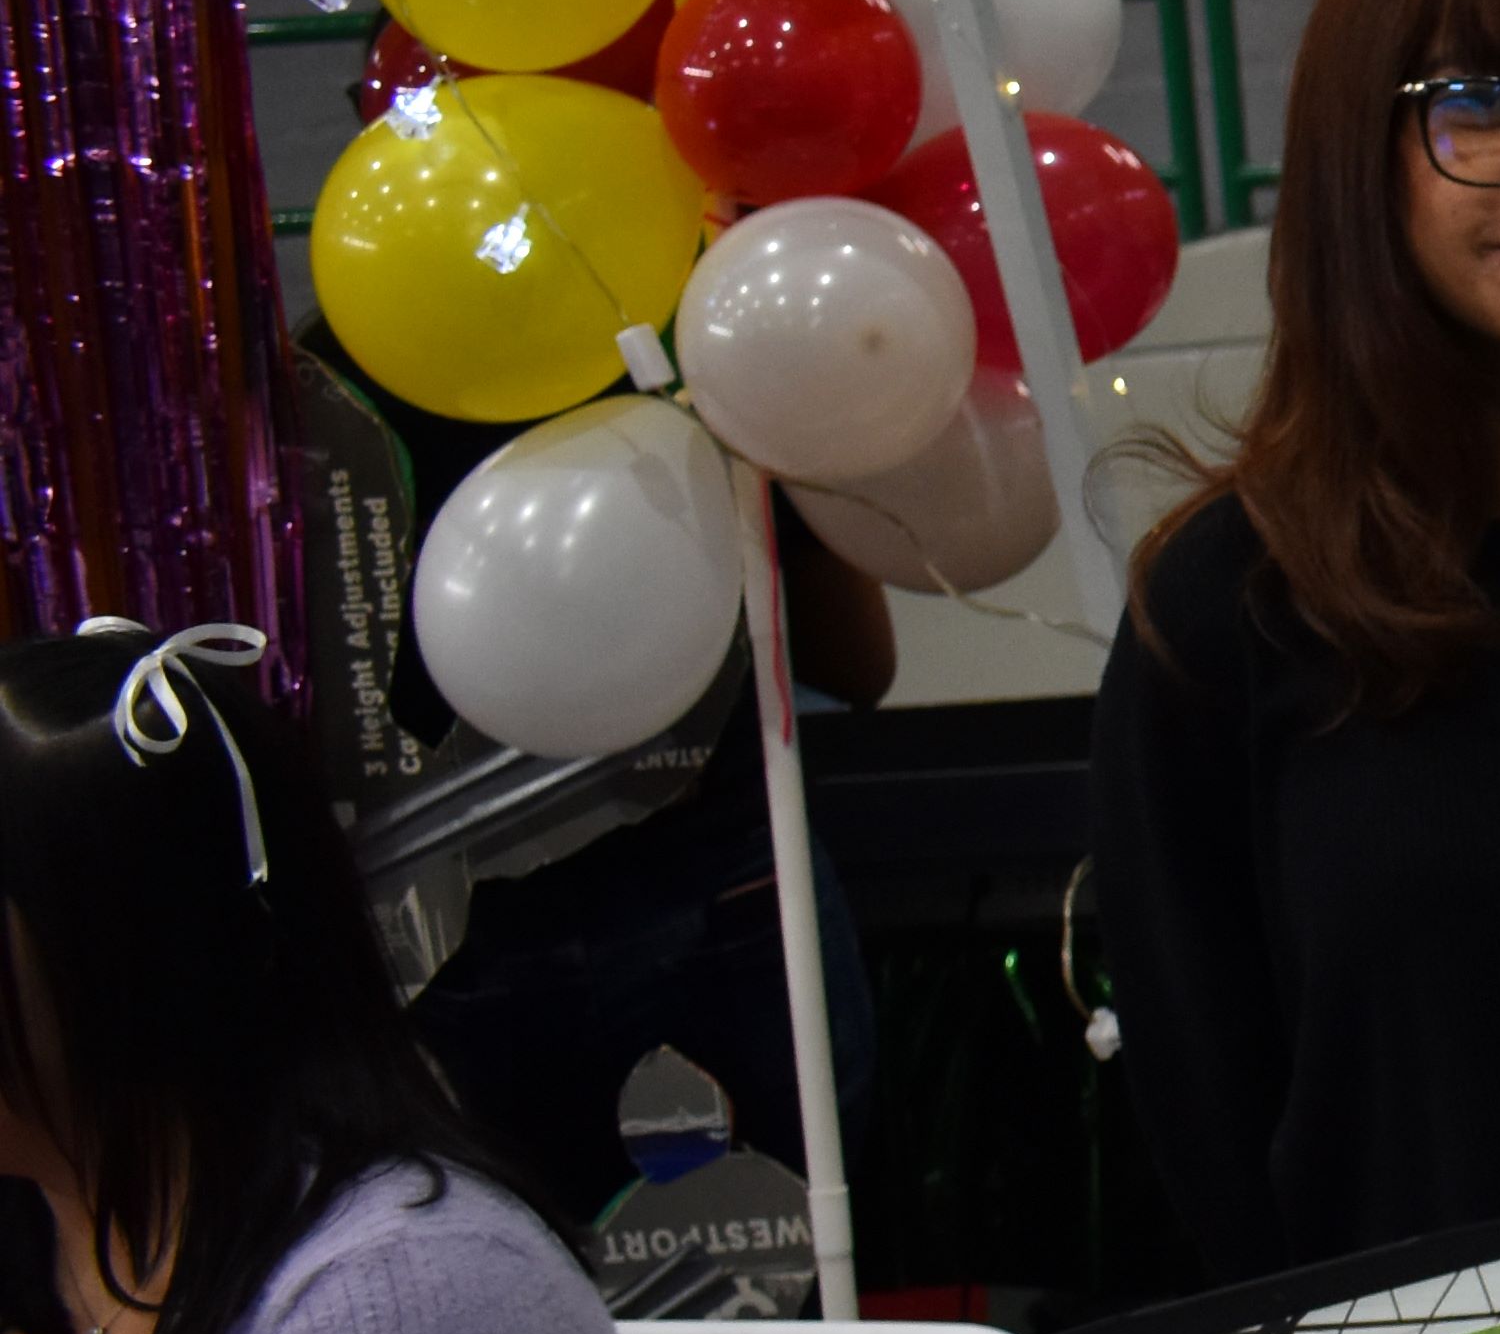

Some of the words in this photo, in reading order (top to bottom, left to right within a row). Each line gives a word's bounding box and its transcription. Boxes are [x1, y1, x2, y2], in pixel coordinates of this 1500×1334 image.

[329, 469, 372, 649] Adjustments
[364, 496, 401, 619] Included
[353, 661, 385, 752] Height
